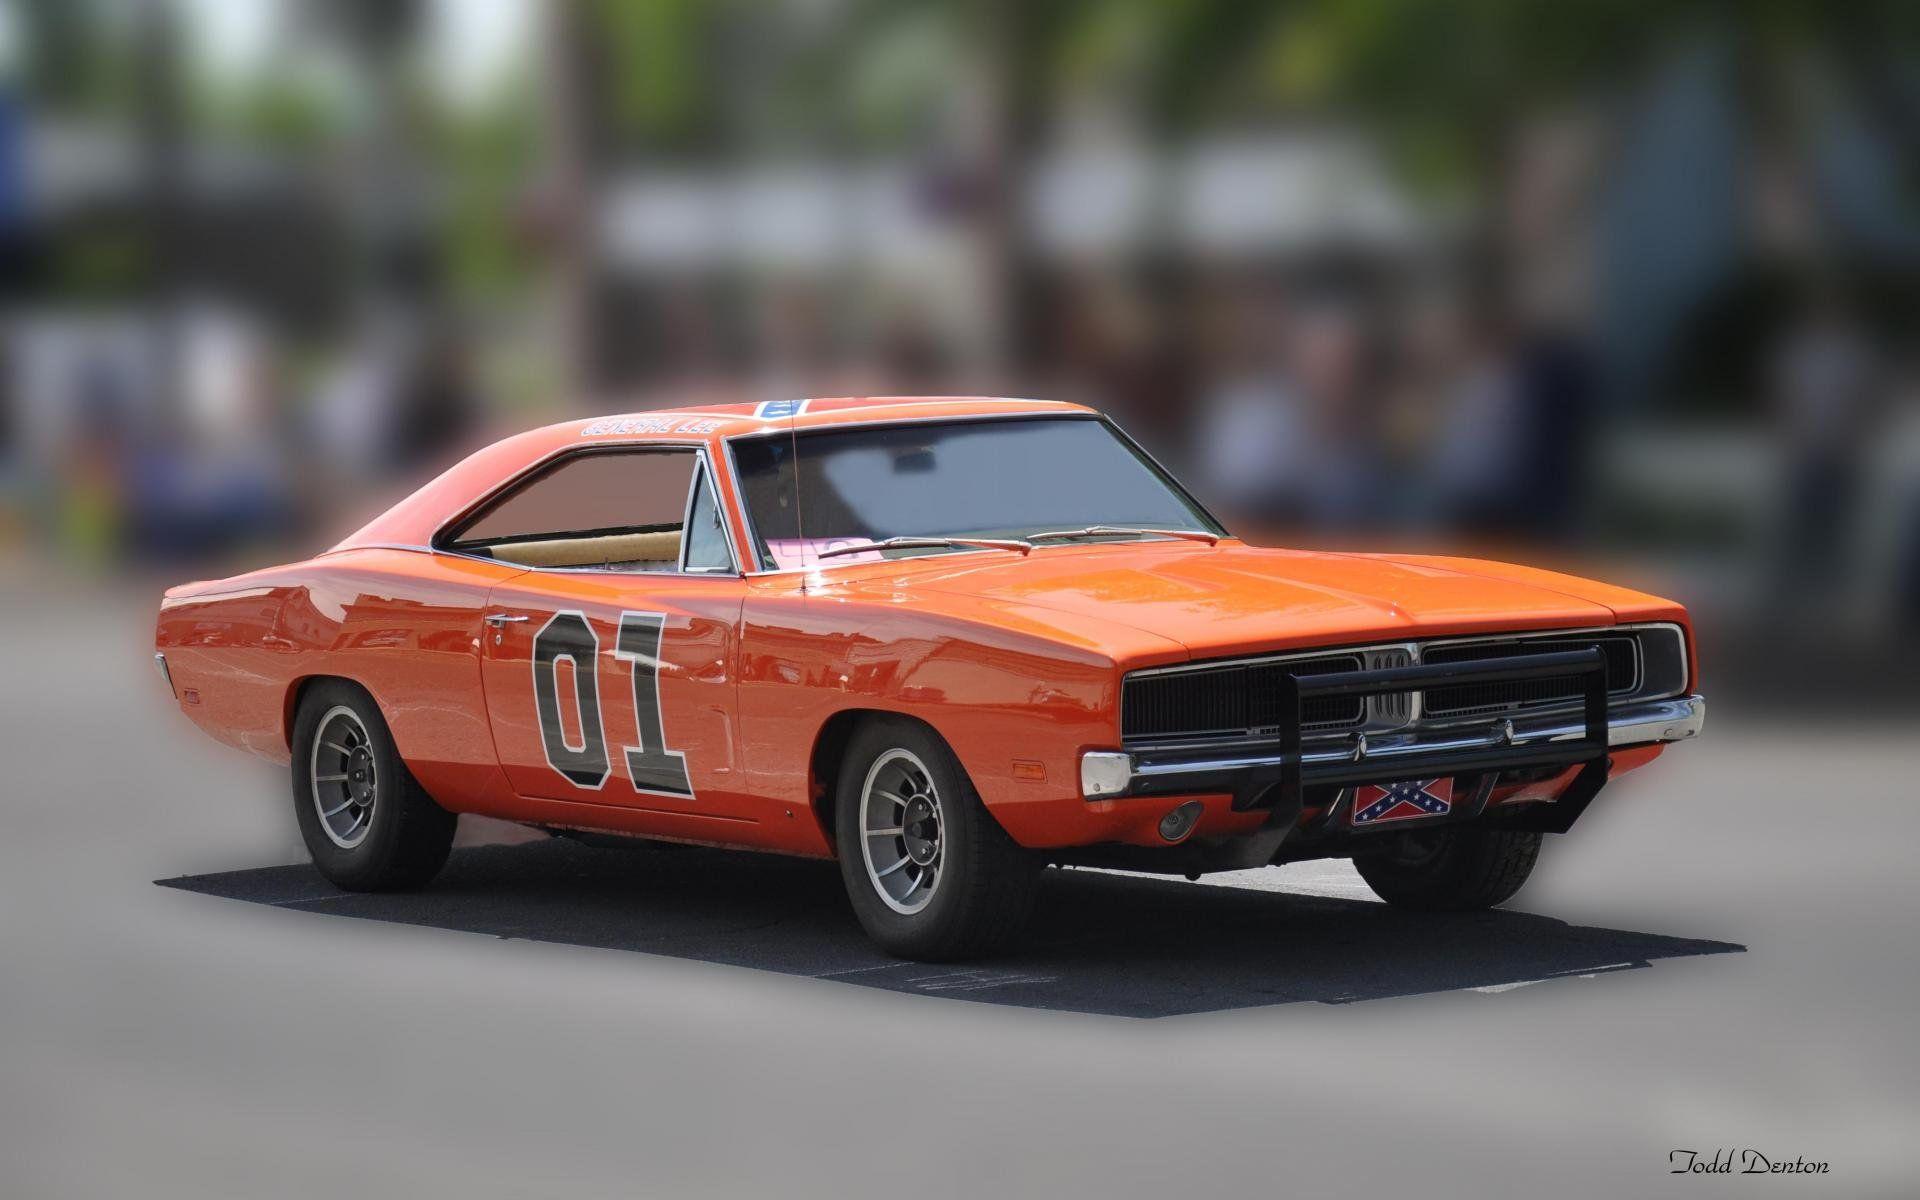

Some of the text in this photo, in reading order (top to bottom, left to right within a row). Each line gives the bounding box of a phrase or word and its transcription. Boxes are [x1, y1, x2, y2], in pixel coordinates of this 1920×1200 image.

[581, 417, 721, 436] GENERAL LEE
[532, 609, 696, 800] 01
